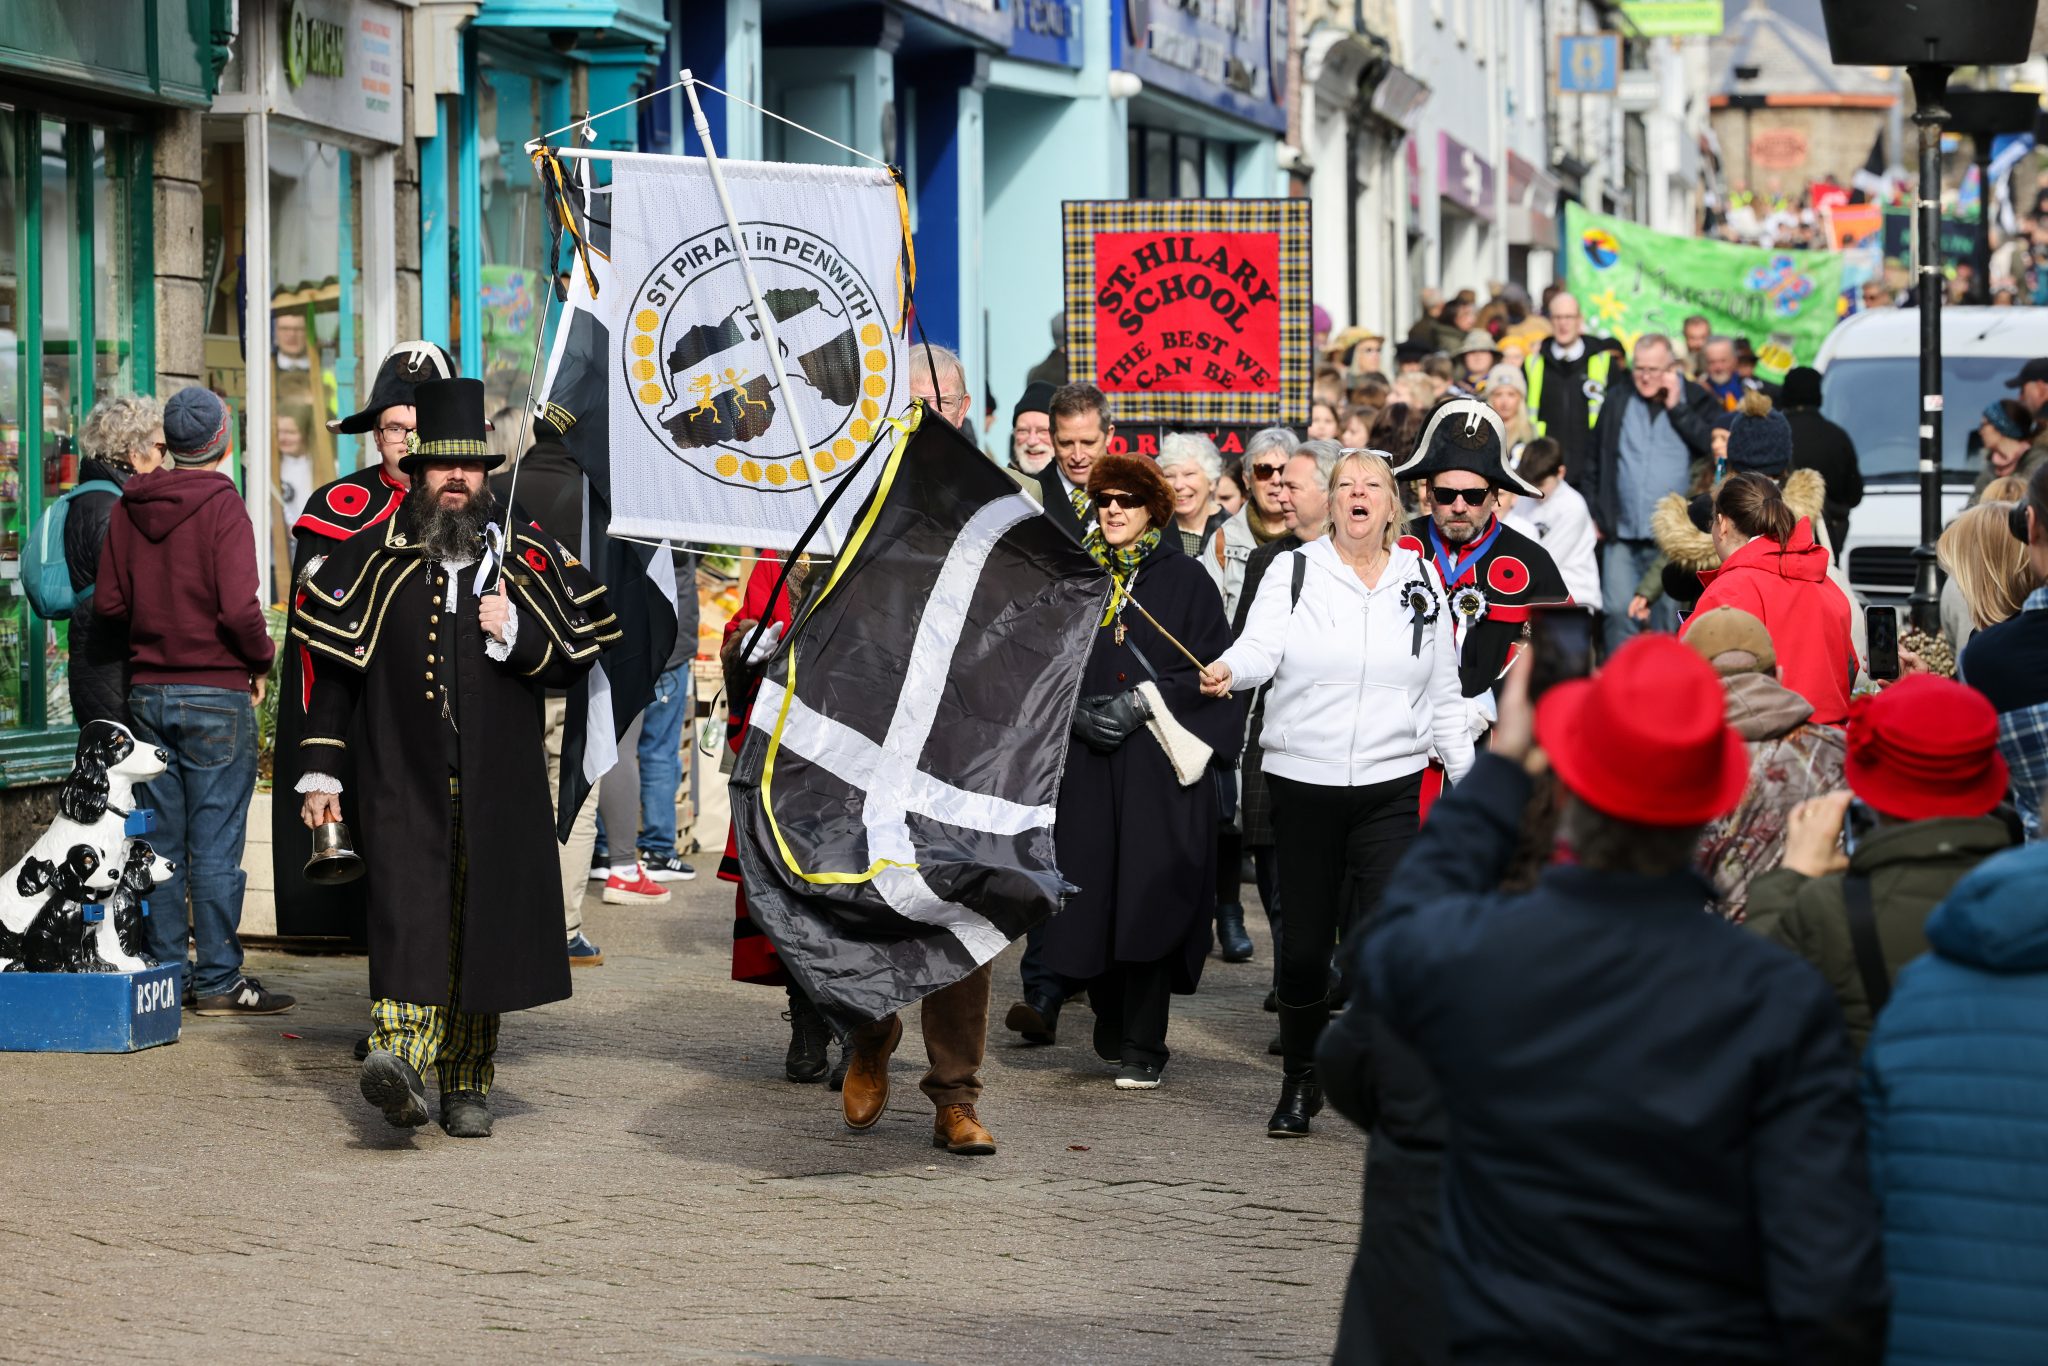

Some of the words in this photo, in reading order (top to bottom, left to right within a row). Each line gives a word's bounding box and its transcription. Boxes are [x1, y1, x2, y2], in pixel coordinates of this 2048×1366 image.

[647, 274, 675, 307] ST
[757, 231, 777, 252] in
[783, 235, 873, 320] PENWITH
[1118, 274, 1250, 336] SCHOOL
[1104, 341, 1152, 386] THE
[1160, 330, 1229, 356] BEST
[1234, 348, 1271, 387] WE
[1136, 356, 1193, 389] CAN
[1203, 361, 1237, 390] BE
[137, 977, 175, 1015] RSPCA
